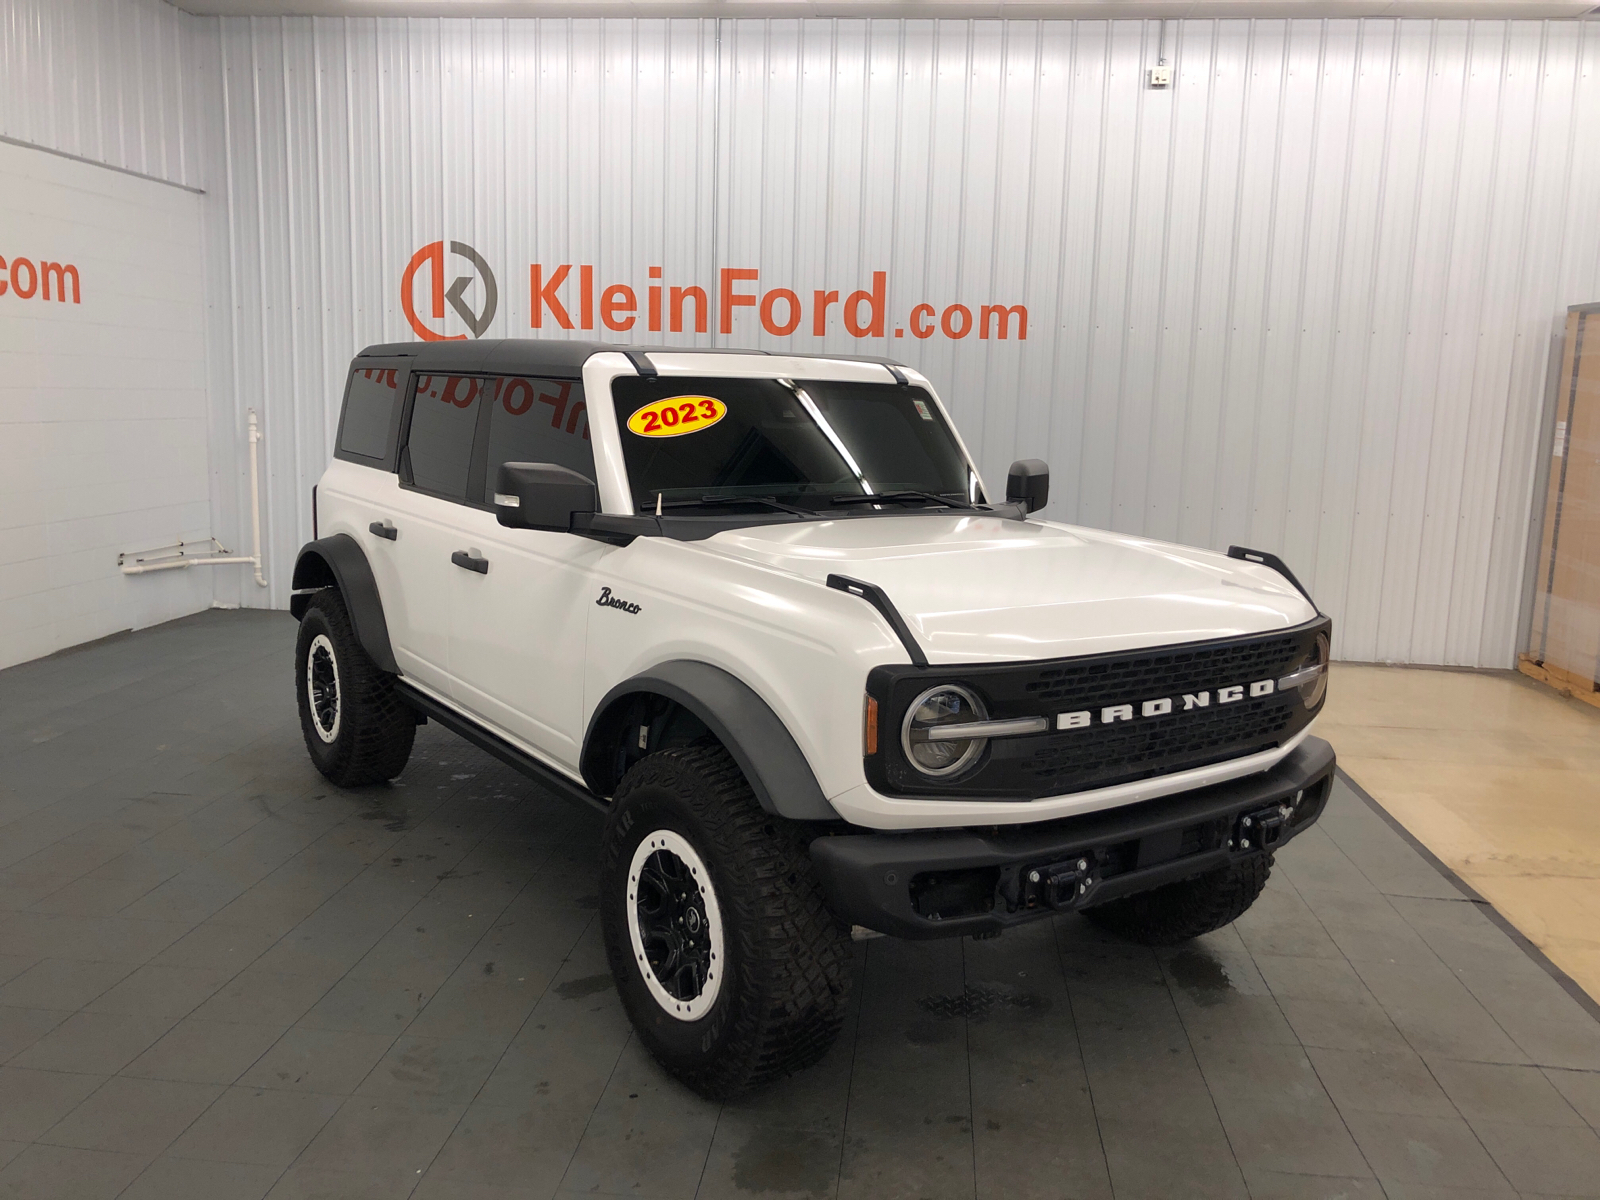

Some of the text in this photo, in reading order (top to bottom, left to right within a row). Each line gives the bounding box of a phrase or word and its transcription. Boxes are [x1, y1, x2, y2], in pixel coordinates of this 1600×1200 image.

[530, 263, 1028, 340] KleinFord.com
[640, 399, 718, 433] 2023
[595, 586, 642, 615] Bronco
[1057, 679, 1274, 730] BRONCO
